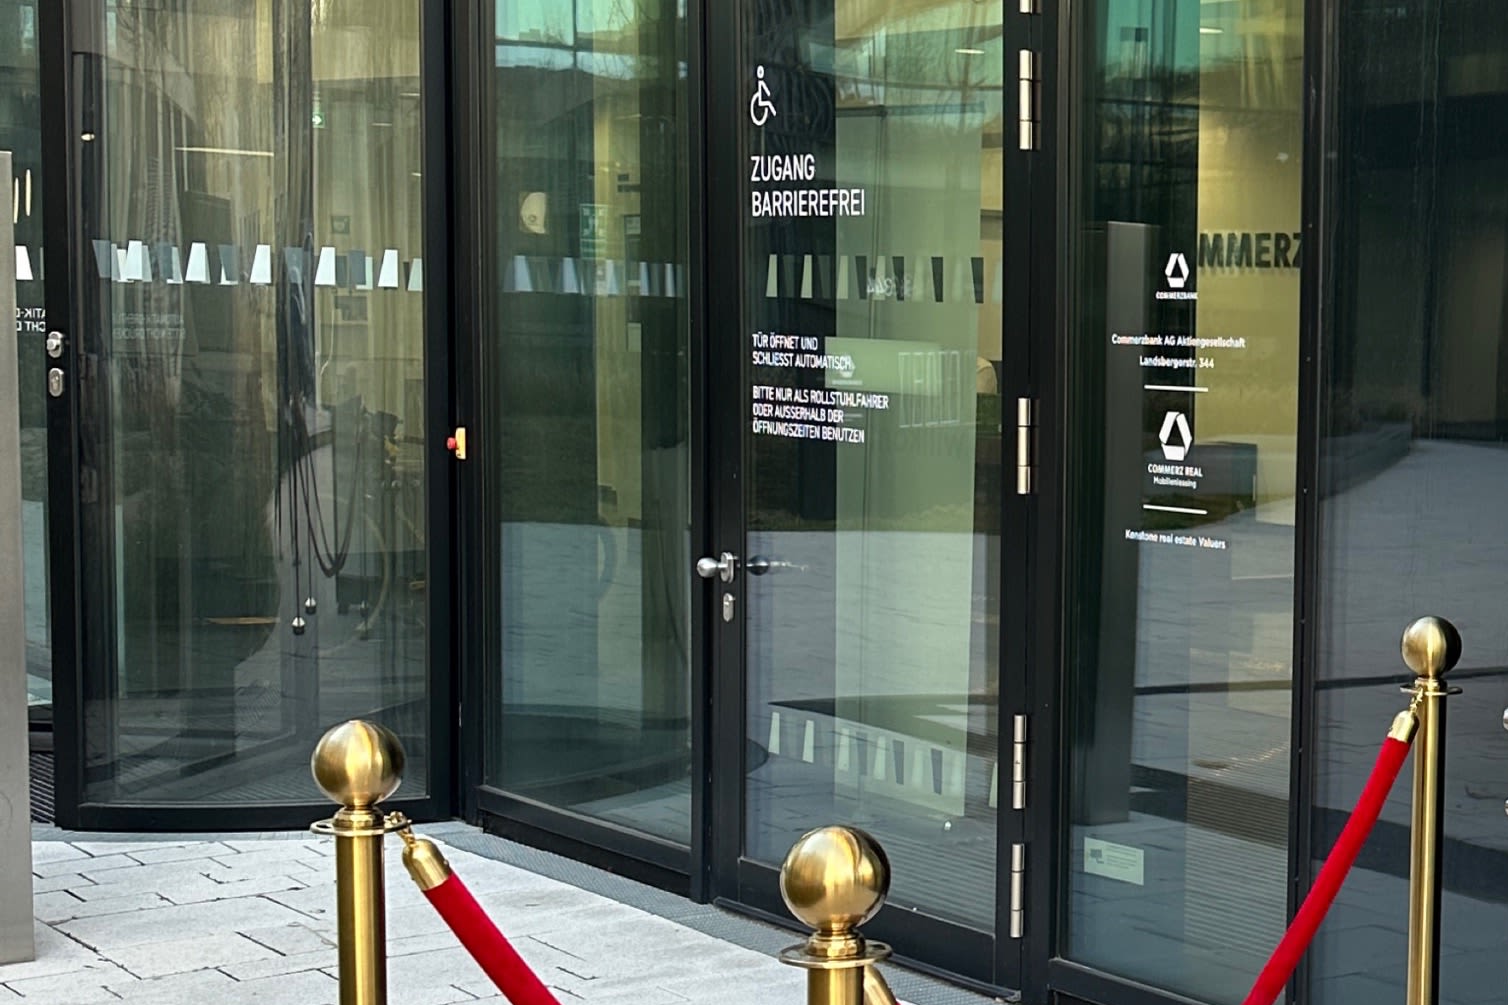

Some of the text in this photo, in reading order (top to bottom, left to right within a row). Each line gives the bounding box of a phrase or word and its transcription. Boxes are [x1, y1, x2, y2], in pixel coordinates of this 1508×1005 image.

[750, 154, 816, 182] ZUGANG
[751, 188, 865, 217] BARRIEREFREI
[752, 331, 818, 351] TÜR ÖFFNET UND
[1112, 333, 1246, 349] Commerzbank AG Aktiengesellschaft
[752, 351, 794, 367] SCHLIESST
[1199, 357, 1214, 369] 344
[752, 385, 889, 409] BITTE NUR ALS ROLLSTUHLFAHRER
[752, 403, 844, 423] ODER AUSSERHALB DER
[752, 418, 865, 443] ÖFFNUNGSZEITEN BENUTZEN
[1148, 463, 1203, 477] COMMERZ REAL
[1159, 532, 1173, 544] real
[1174, 535, 1197, 546] estate
[1198, 537, 1226, 550] Valuers
